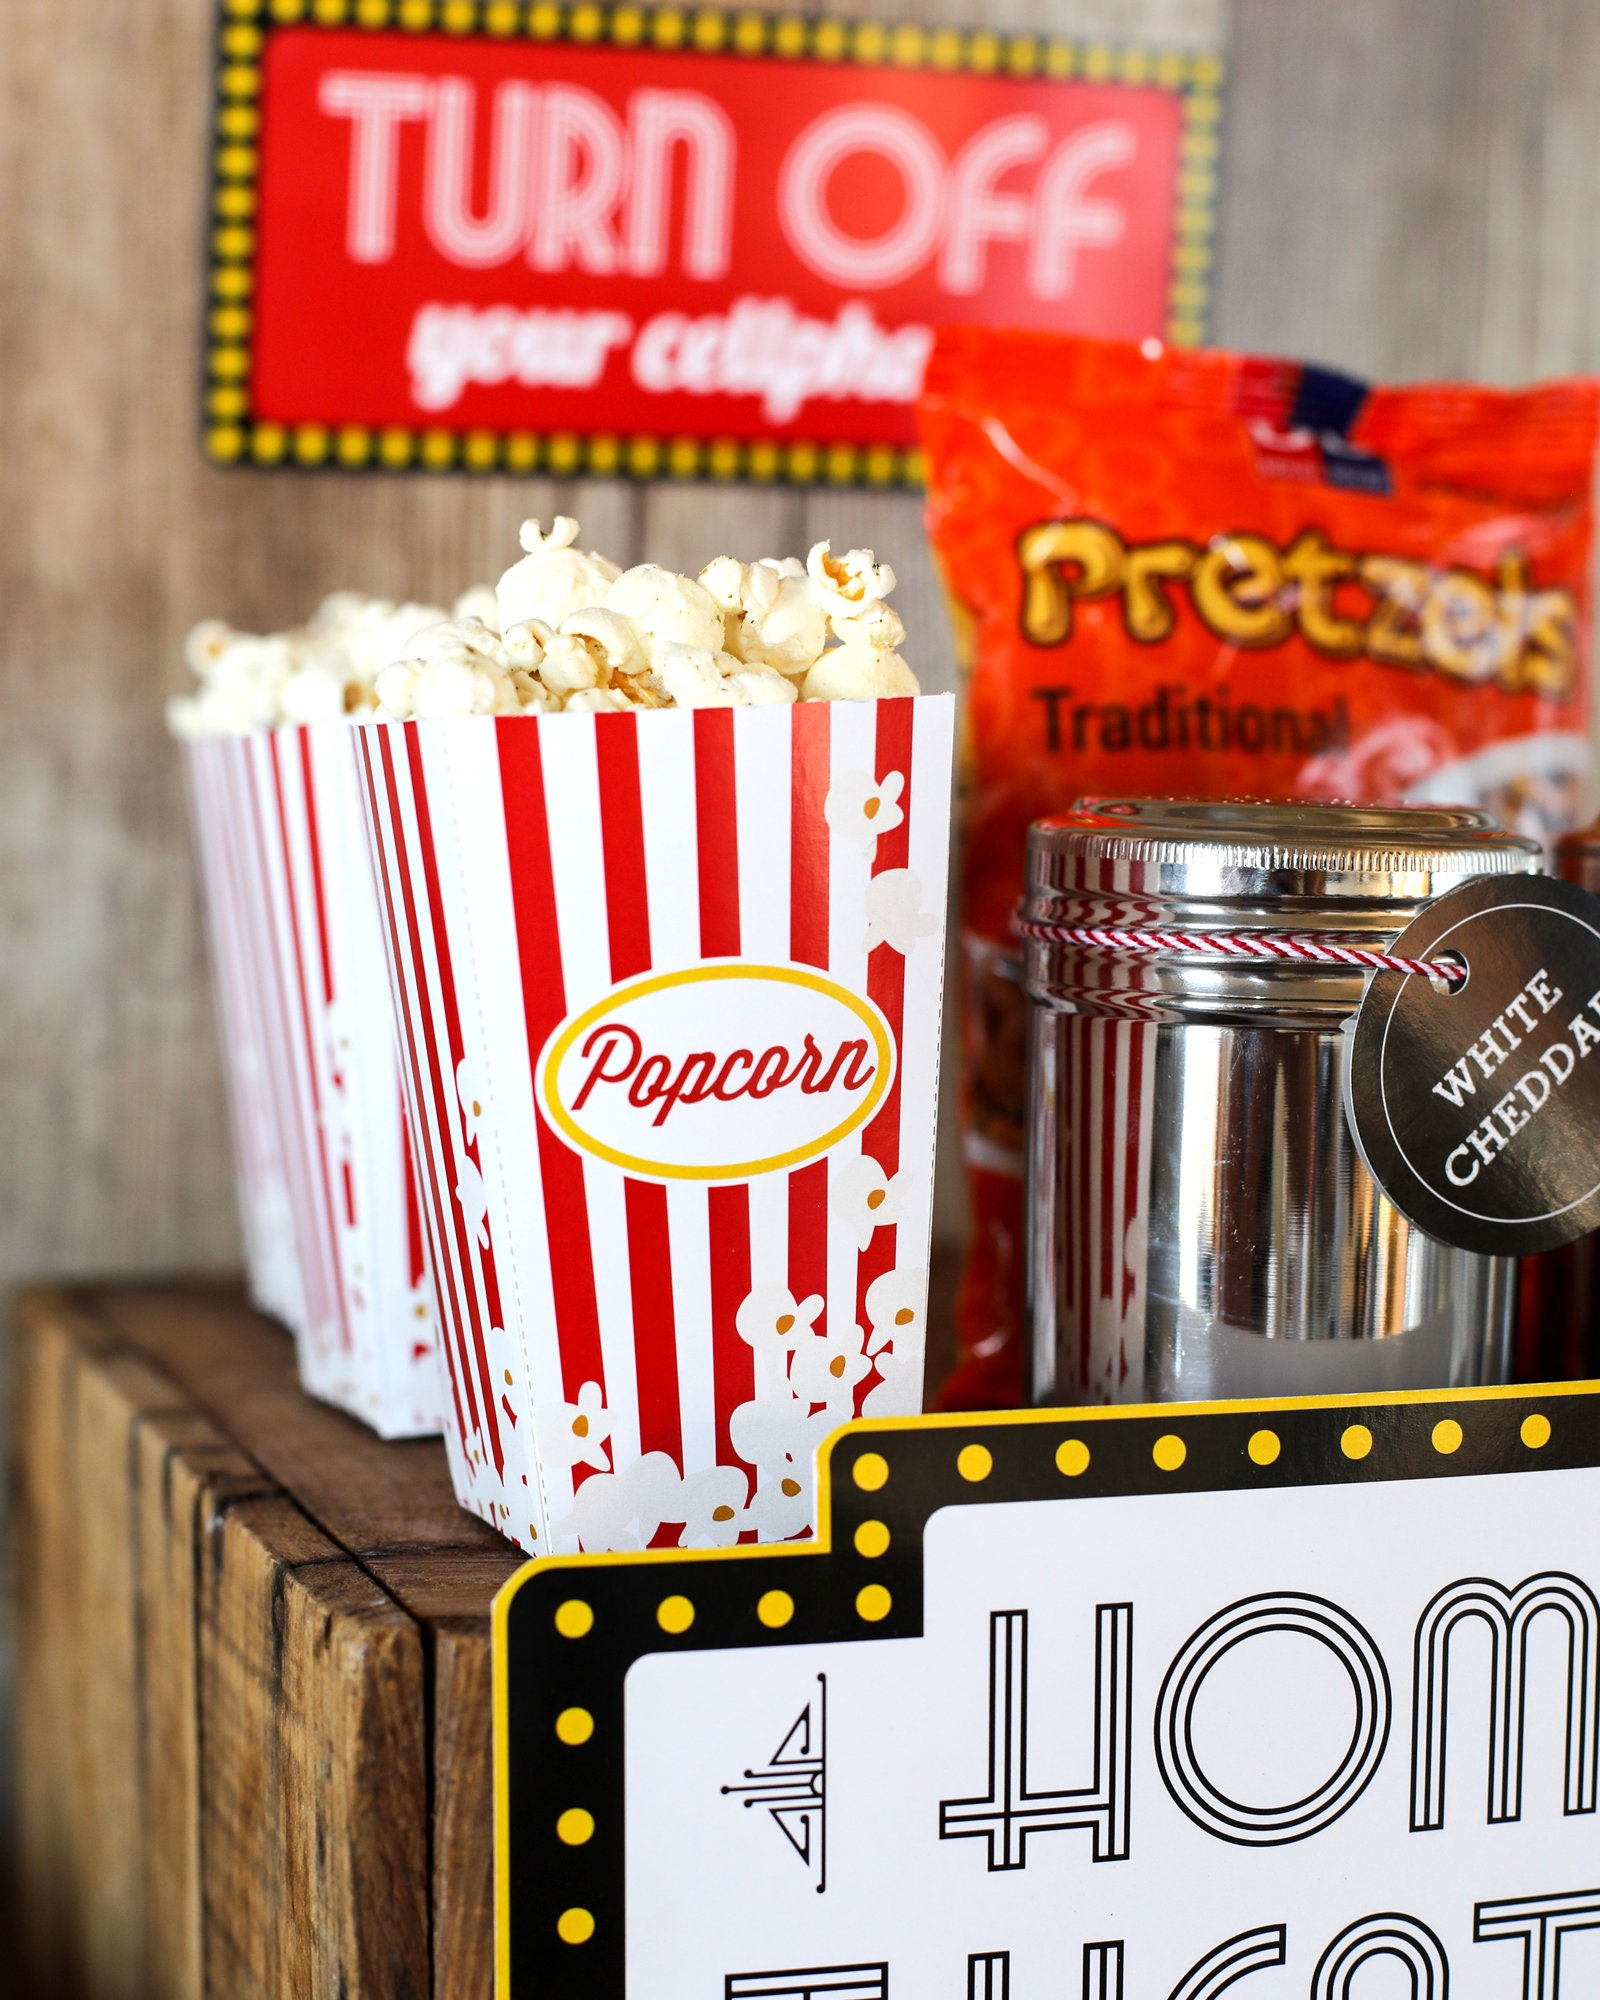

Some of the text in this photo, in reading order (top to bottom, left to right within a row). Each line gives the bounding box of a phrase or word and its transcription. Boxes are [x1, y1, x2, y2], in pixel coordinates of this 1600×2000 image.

[318, 71, 1138, 301] TURN OFF
[406, 302, 633, 412] your
[1016, 516, 1576, 694] Pretzels
[1029, 682, 1350, 755] Traditional
[570, 1022, 876, 1128] Popcorn
[1432, 967, 1563, 1108] WHITE
